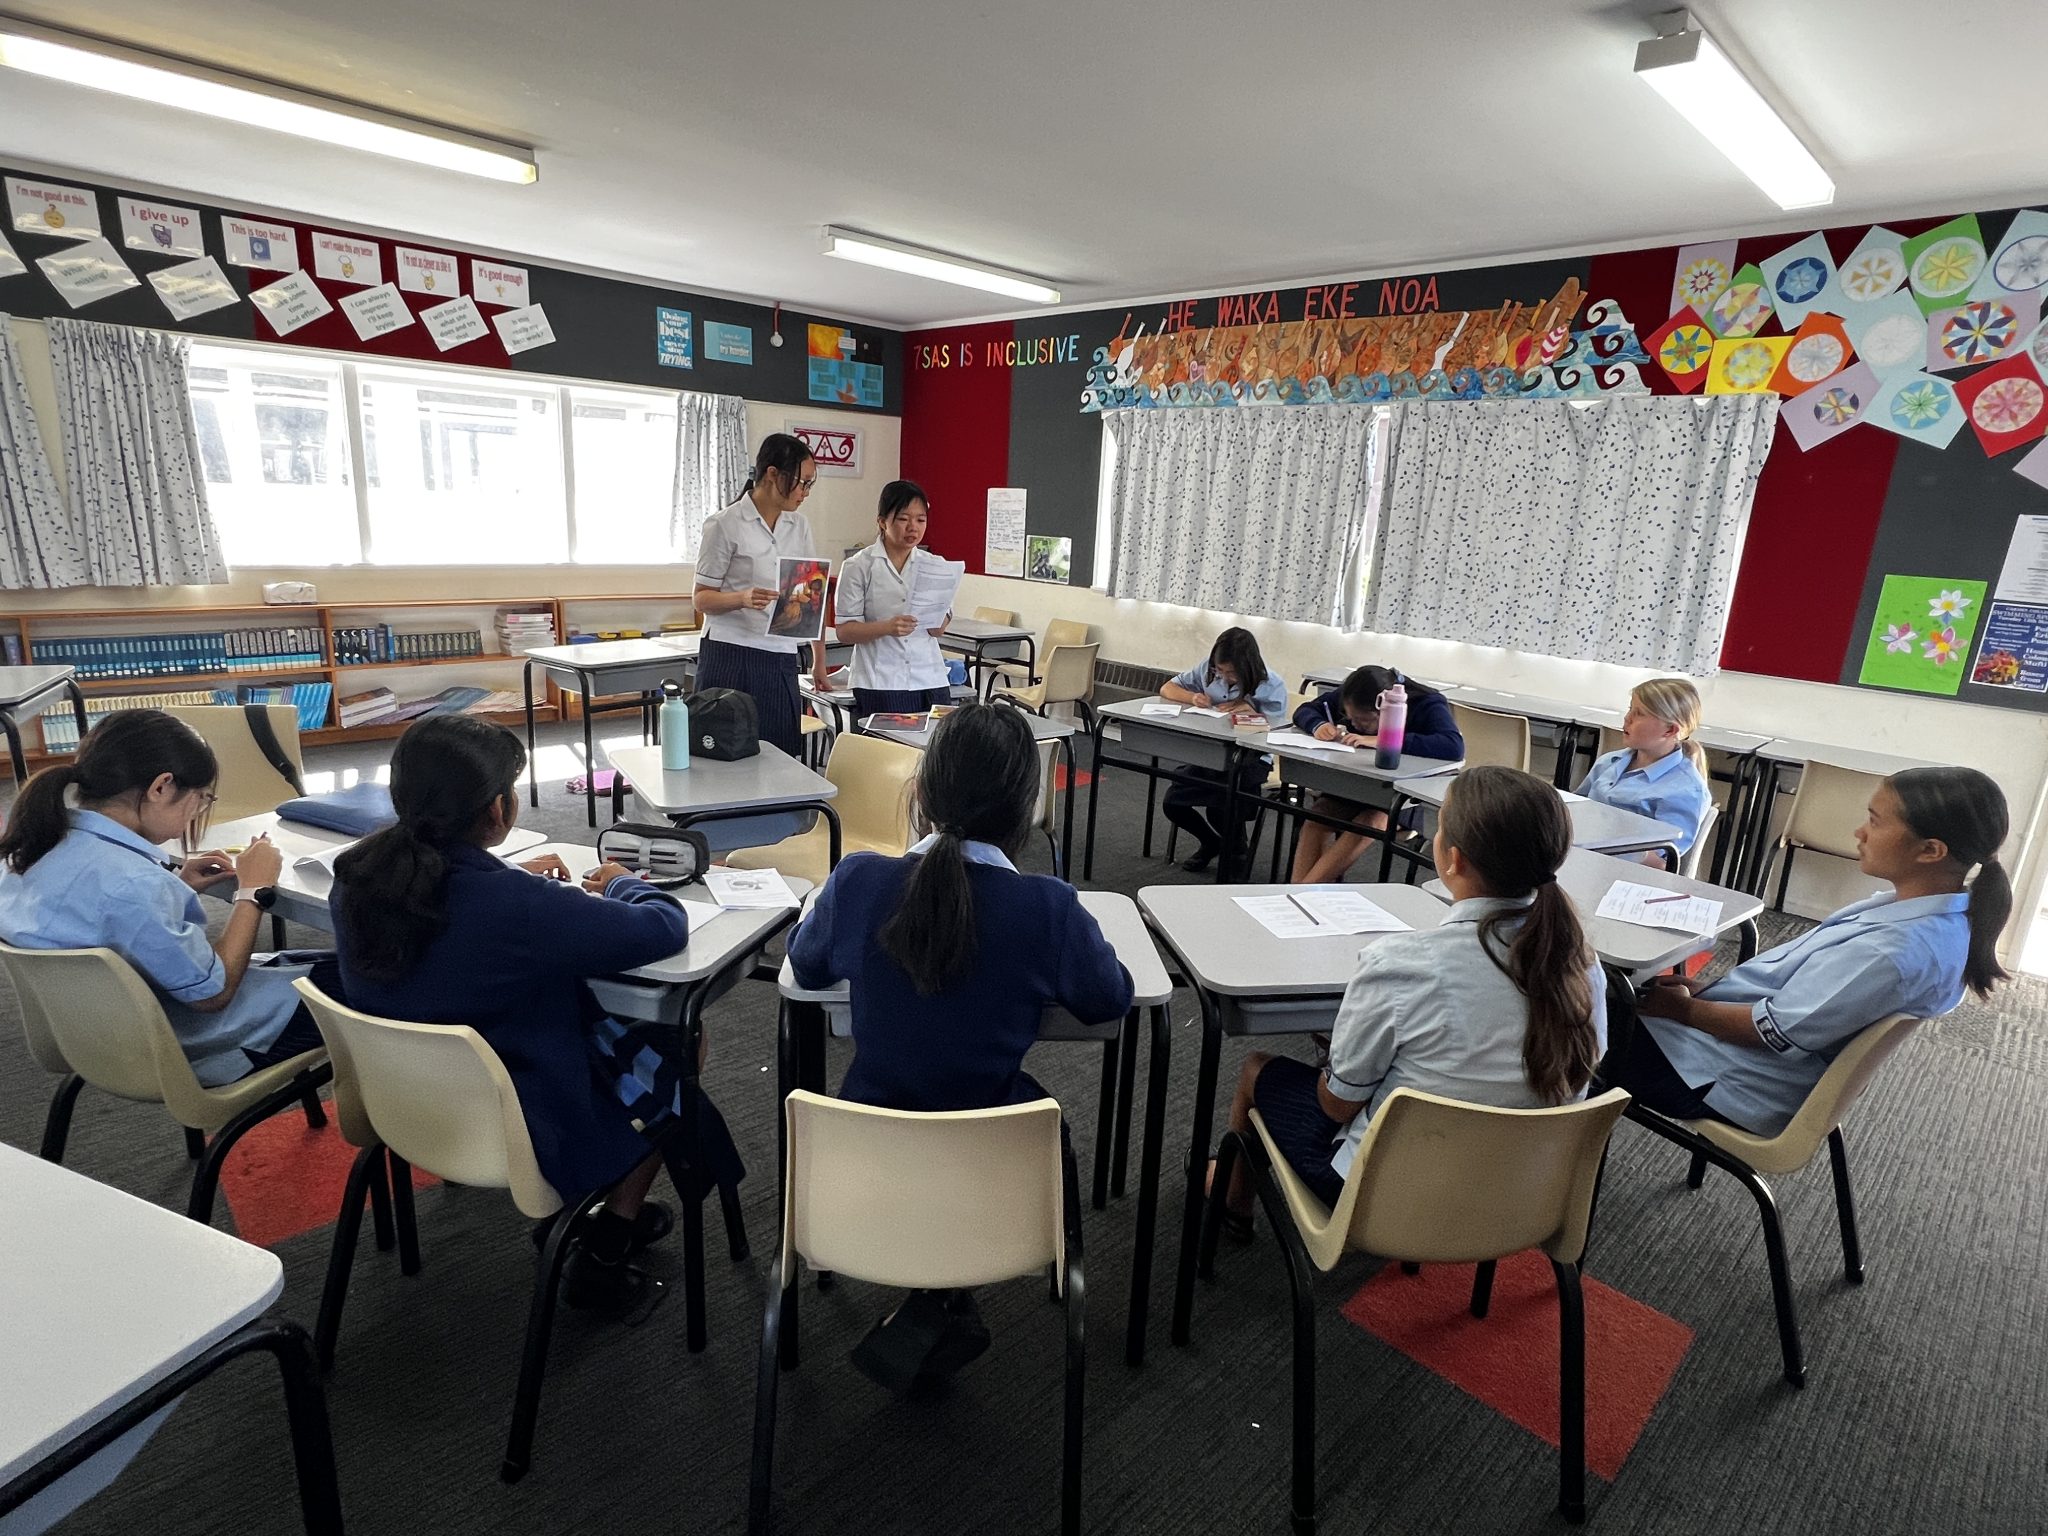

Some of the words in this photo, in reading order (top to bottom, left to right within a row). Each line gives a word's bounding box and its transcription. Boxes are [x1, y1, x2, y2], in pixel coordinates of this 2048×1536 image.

[29, 189, 43, 199] not
[43, 190, 62, 202] good
[63, 194, 71, 203] at
[130, 205, 136, 217] I
[140, 208, 168, 221] give
[171, 213, 189, 227] up
[230, 223, 246, 235] This
[247, 226, 254, 236] is
[255, 228, 268, 239] too
[269, 229, 289, 242] hard.
[61, 264, 88, 278] What
[488, 270, 502, 282] good
[503, 272, 524, 287] enough
[283, 281, 298, 292] may
[289, 289, 308, 302] some
[354, 299, 368, 308] can
[368, 291, 391, 303] always
[288, 303, 304, 313] time
[457, 303, 469, 311] out
[1167, 299, 1199, 332] HE
[1217, 291, 1280, 328] WAKA
[1303, 283, 1360, 321] EKE
[1378, 275, 1440, 315] NOA
[286, 315, 301, 327] And
[301, 306, 320, 320] effort
[376, 311, 394, 320] keep
[375, 320, 396, 332] trying
[455, 323, 467, 332] and
[466, 320, 476, 328] try
[659, 321, 689, 340] best
[960, 342, 973, 368] IS
[986, 334, 1080, 367] INCLUSIVE
